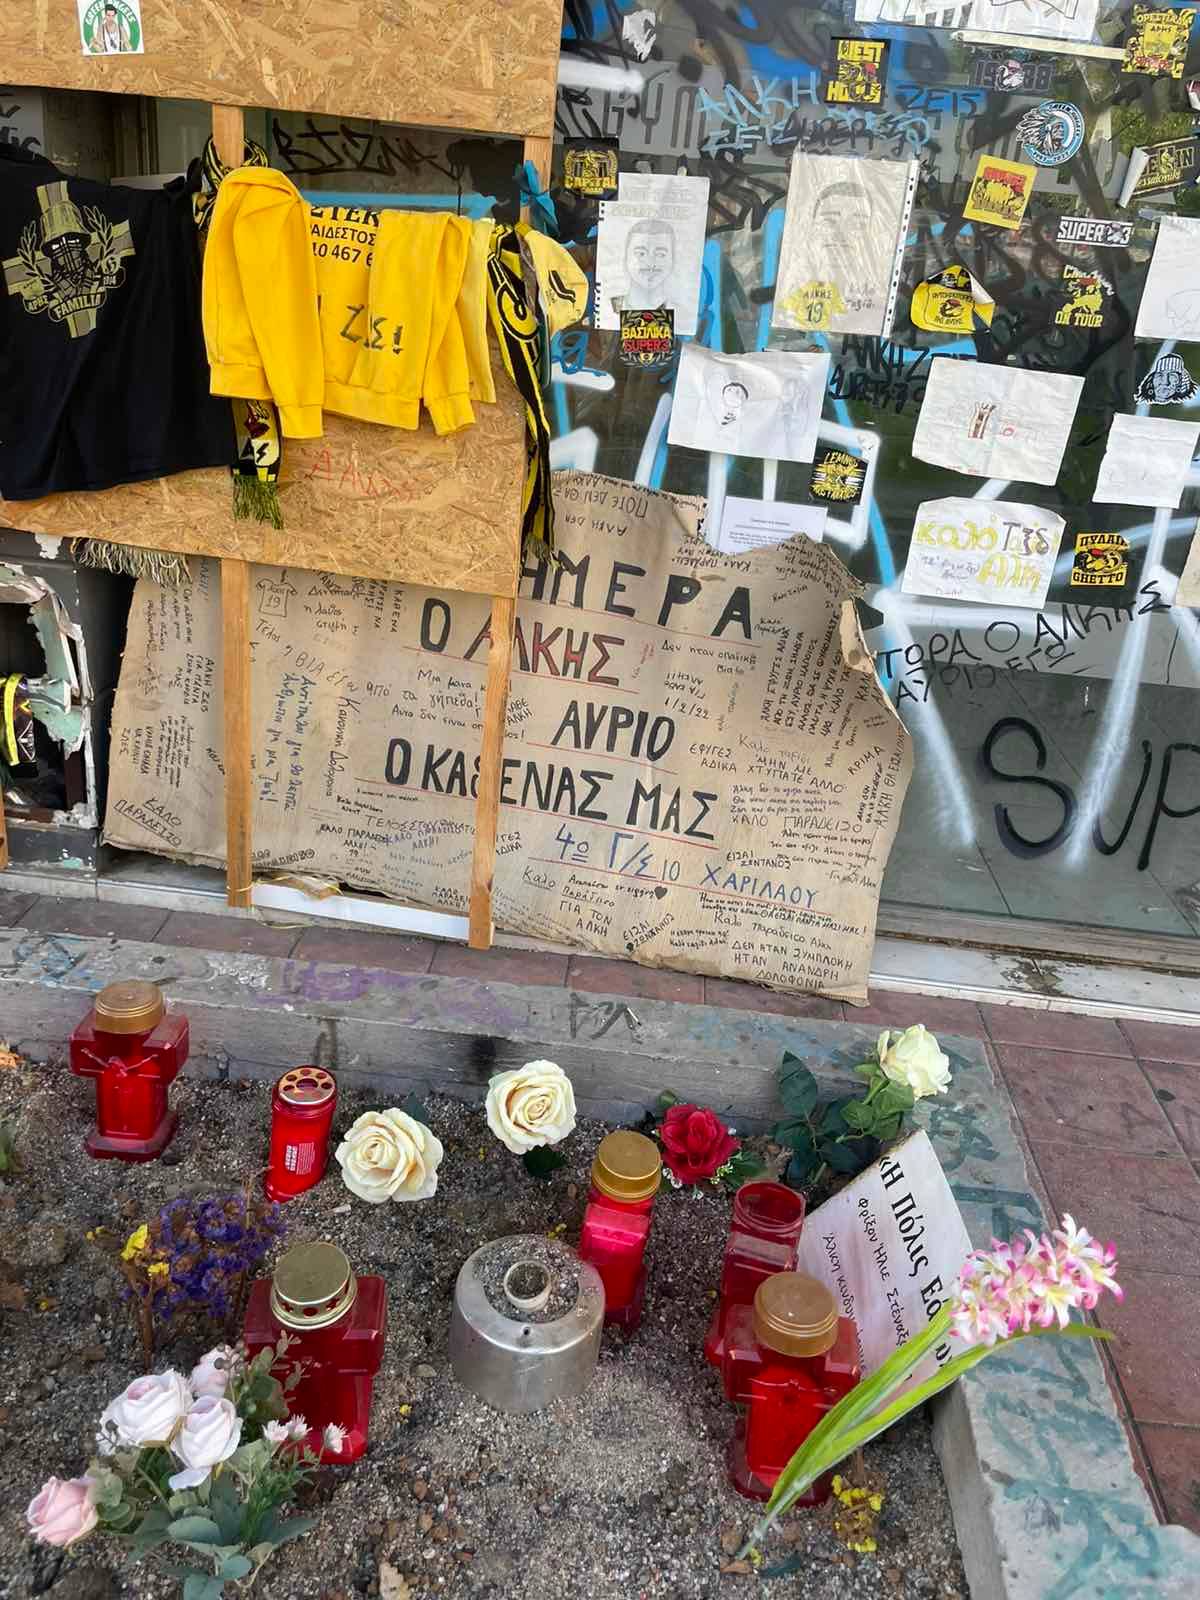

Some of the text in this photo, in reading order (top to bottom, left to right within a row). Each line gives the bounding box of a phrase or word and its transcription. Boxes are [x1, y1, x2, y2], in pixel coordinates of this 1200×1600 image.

[311, 224, 377, 246] ΑΙΔΕΣΤΟΣ
[1057, 221, 1105, 242] SUPER
[331, 244, 361, 263] 467
[1074, 313, 1103, 328] TOUR
[1073, 572, 1123, 584] GHETTO
[518, 549, 753, 641] ΗΜΕΡΑ
[420, 597, 451, 653] Ο
[984, 620, 1020, 653] Ο
[550, 699, 676, 763] ΑΥΡΙΟ
[384, 737, 412, 786] Ο
[625, 777, 719, 842] ΜΑΣ
[730, 814, 769, 828] ΚΑΛΟ
[662, 858, 681, 881] 10
[700, 863, 819, 909] ΧΑΡΙΛΑΟΥ
[559, 901, 613, 925] ΓΙΑ ΤΟΝ
[575, 918, 608, 936] ΑΛΚΗ
[734, 953, 767, 967] ΗΤΑΝ
[879, 1156, 906, 1190] «Η
[891, 1192, 930, 1277] Πόλις
